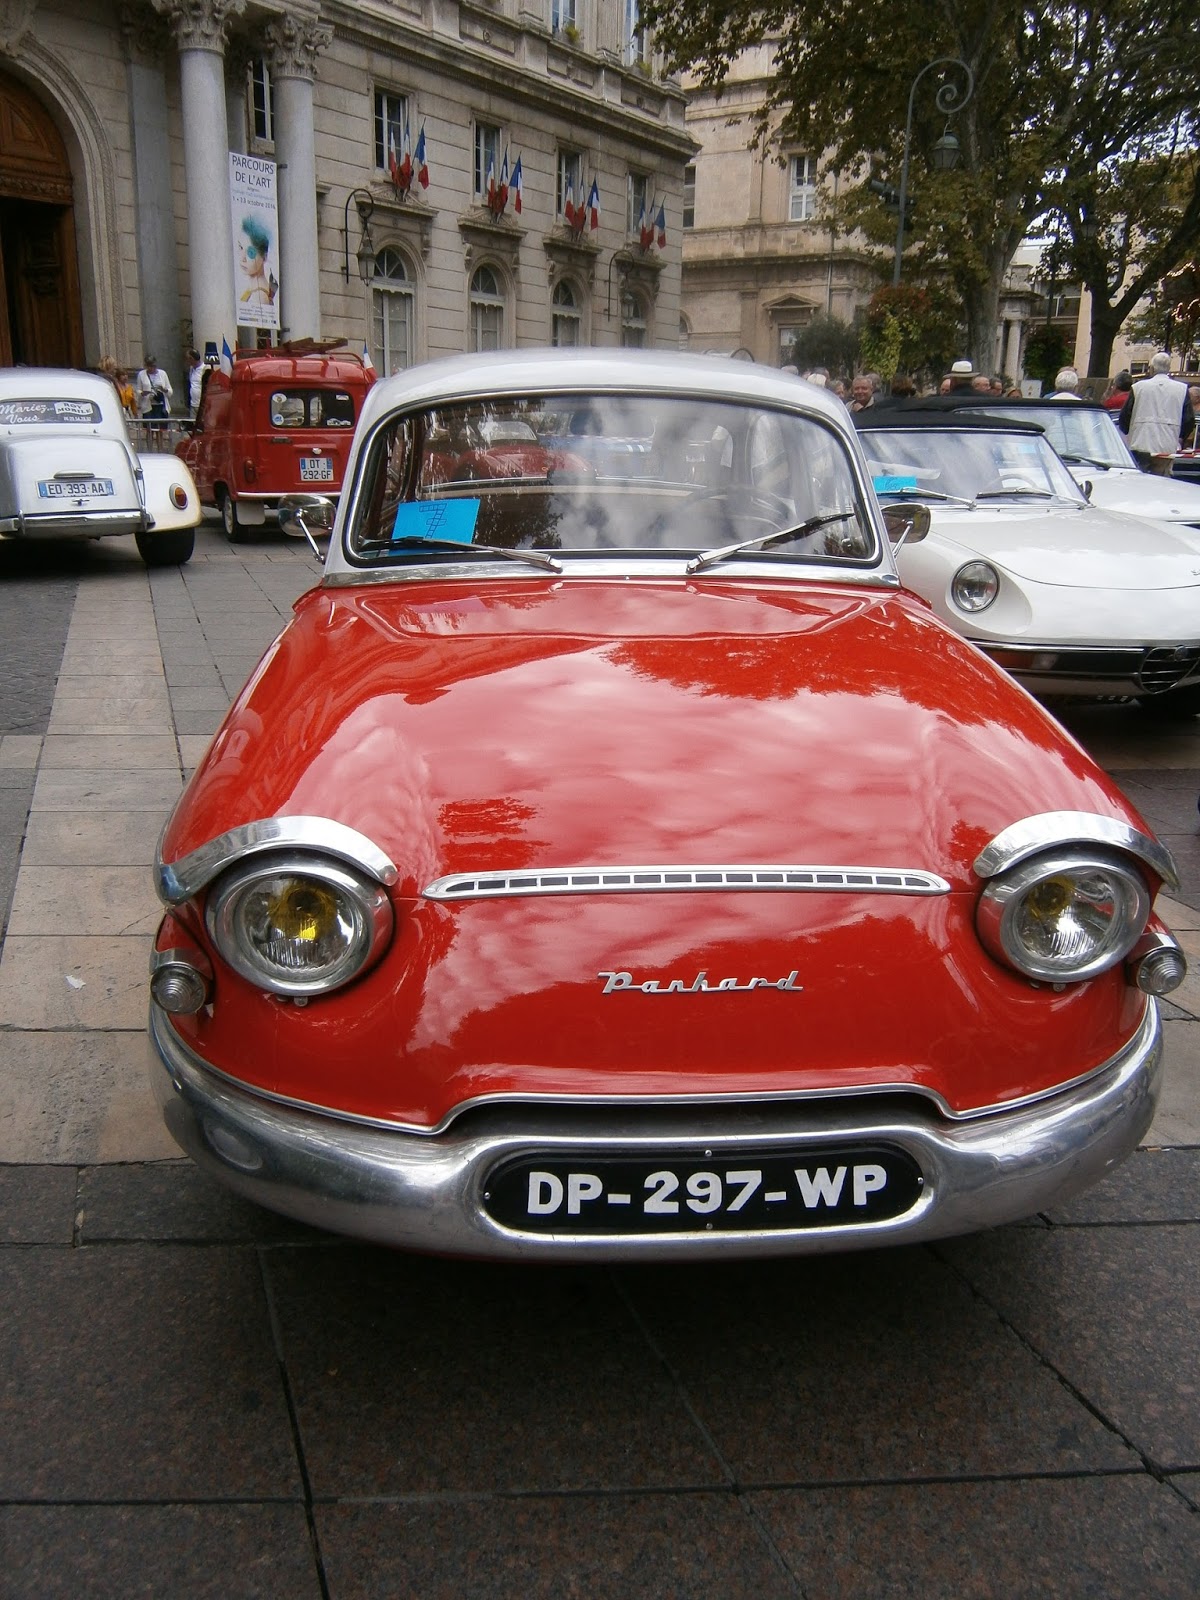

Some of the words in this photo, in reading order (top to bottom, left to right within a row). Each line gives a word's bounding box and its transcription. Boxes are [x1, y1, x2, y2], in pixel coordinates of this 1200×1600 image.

[232, 155, 274, 175] PARCOURS
[235, 171, 246, 183] DE
[248, 174, 271, 189] L'ART
[5, 414, 39, 424] Vous
[303, 470, 332, 480] 292-GF
[597, 970, 804, 994] Panhard
[527, 1164, 888, 1215] DP-297-WP
